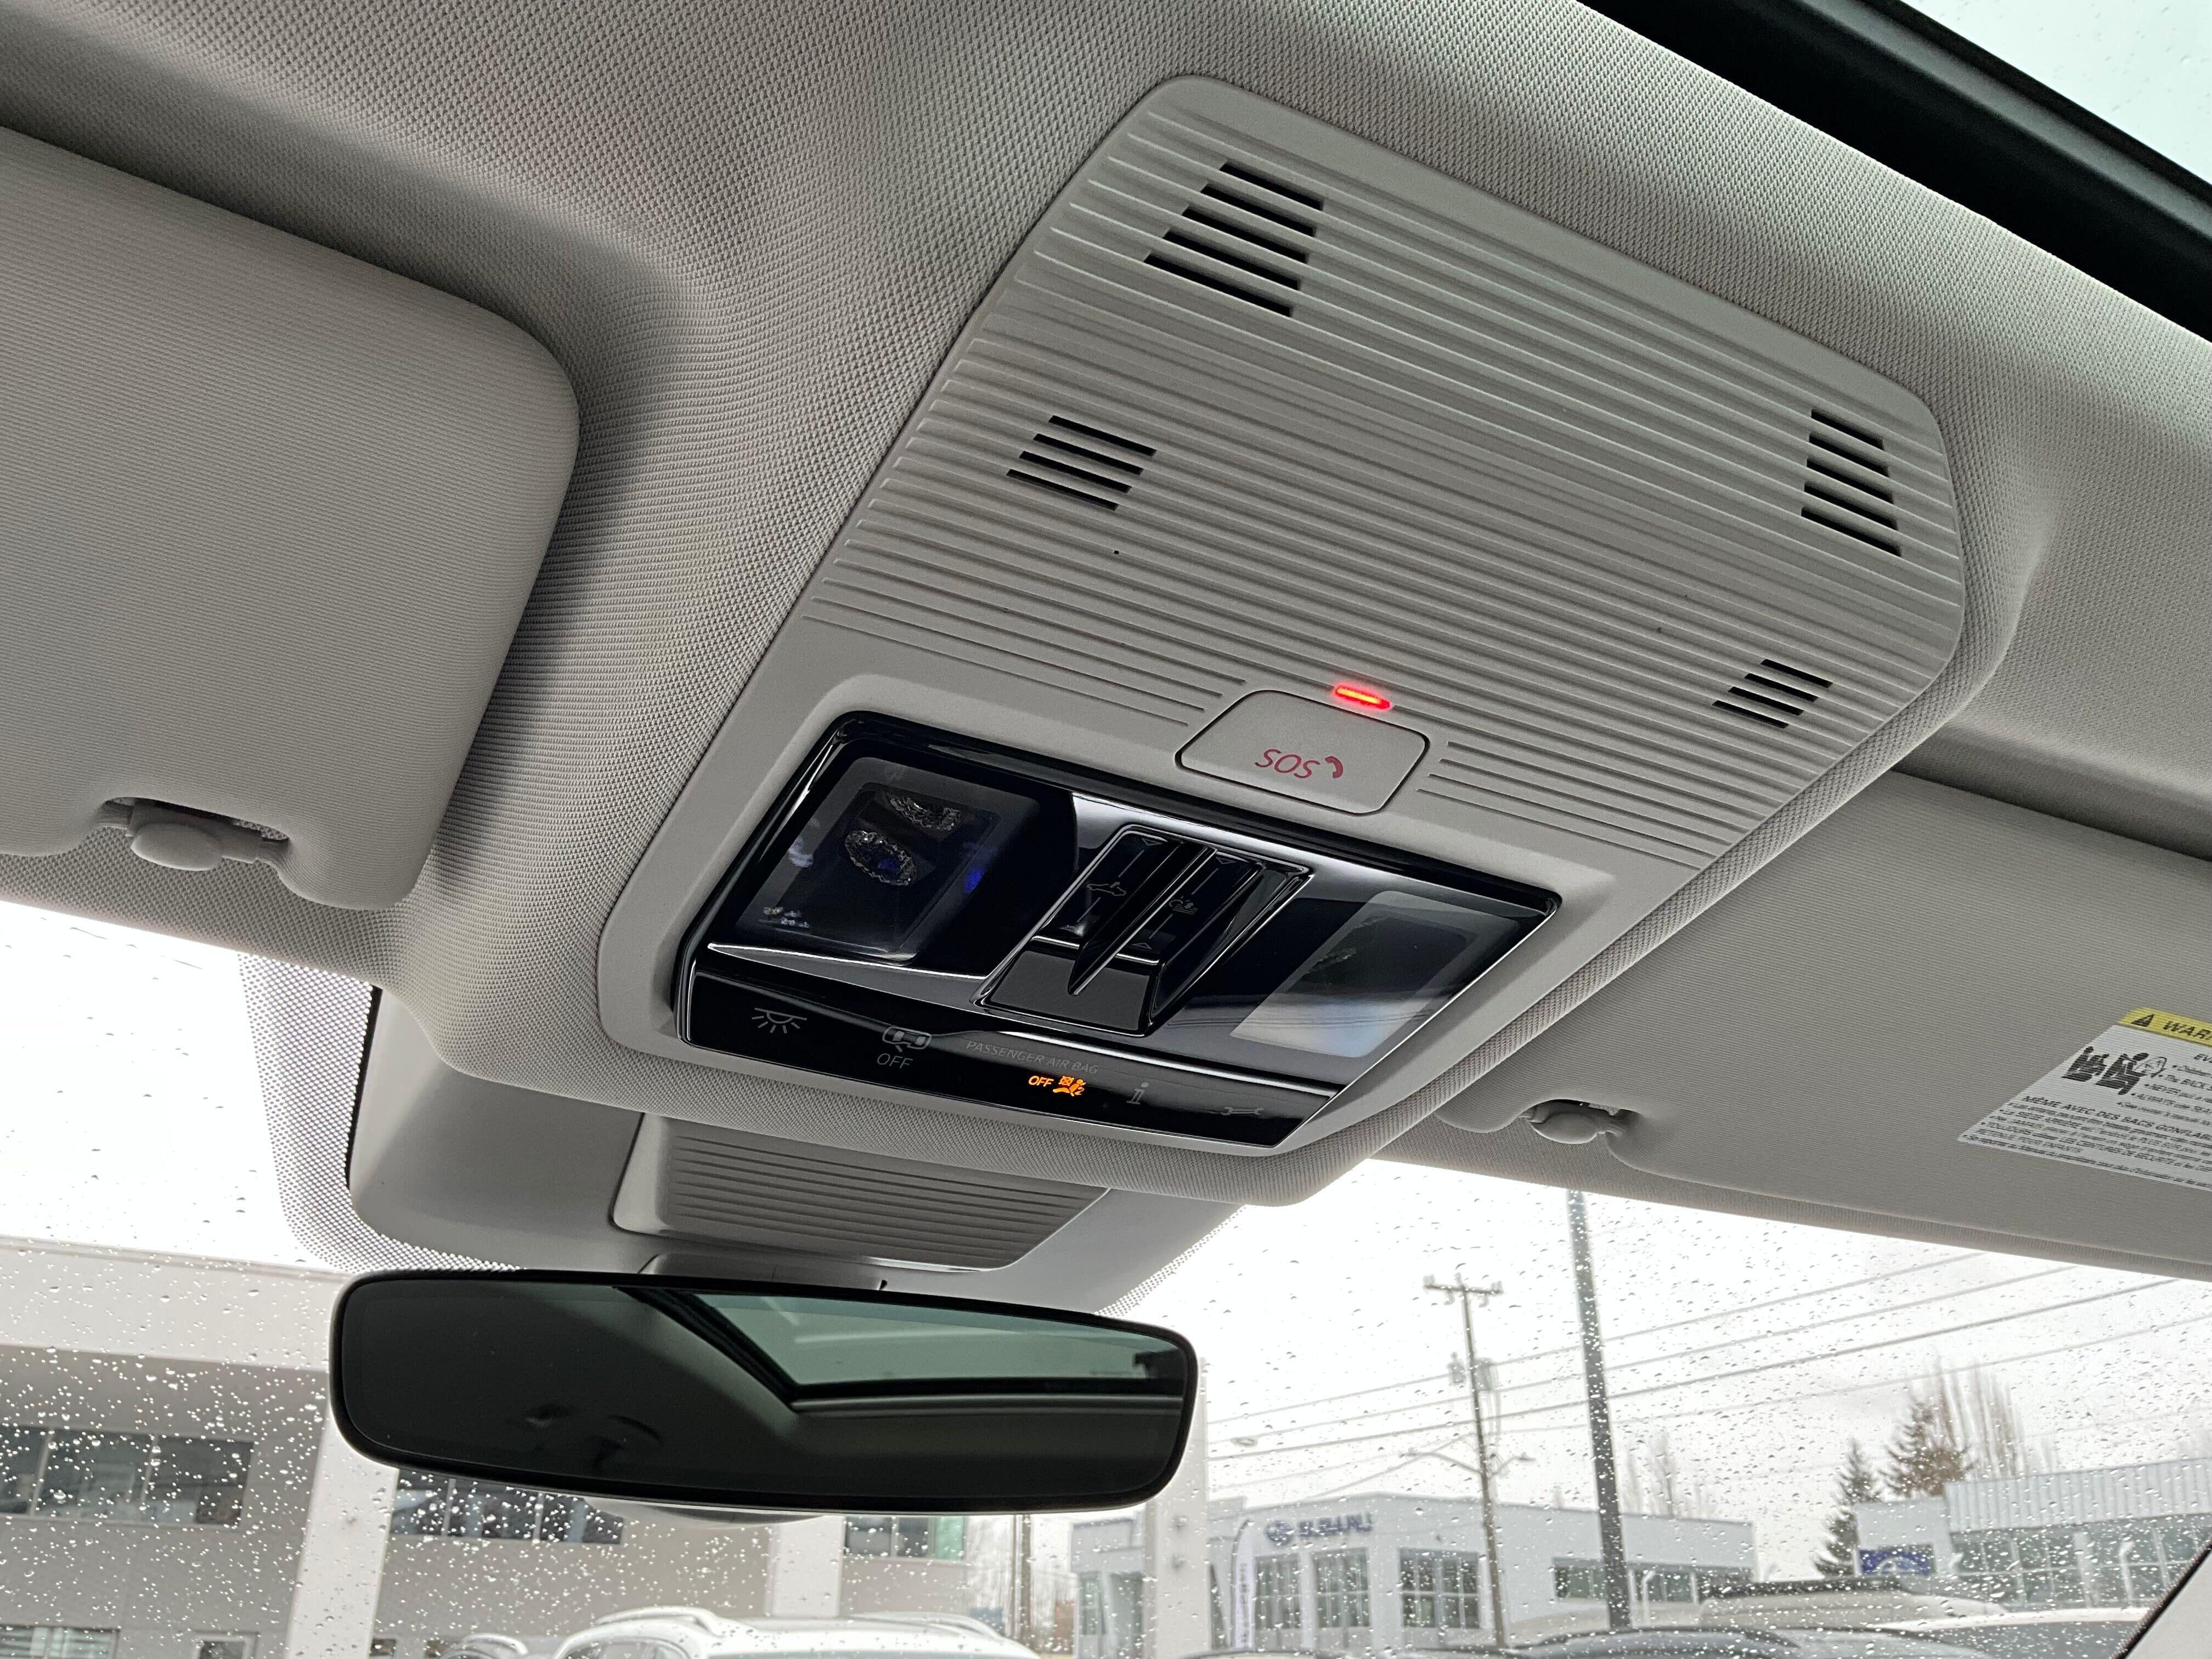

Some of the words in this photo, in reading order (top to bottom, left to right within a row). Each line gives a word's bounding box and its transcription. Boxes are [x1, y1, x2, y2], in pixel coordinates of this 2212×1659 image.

[1255, 748, 1321, 779] SOS
[877, 1053, 913, 1069] OFF
[966, 1041, 1045, 1065] PASSENGER
[1046, 1058, 1073, 1070] AIR
[1071, 1061, 1099, 1075] BAG
[1028, 1075, 1054, 1087] OFF
